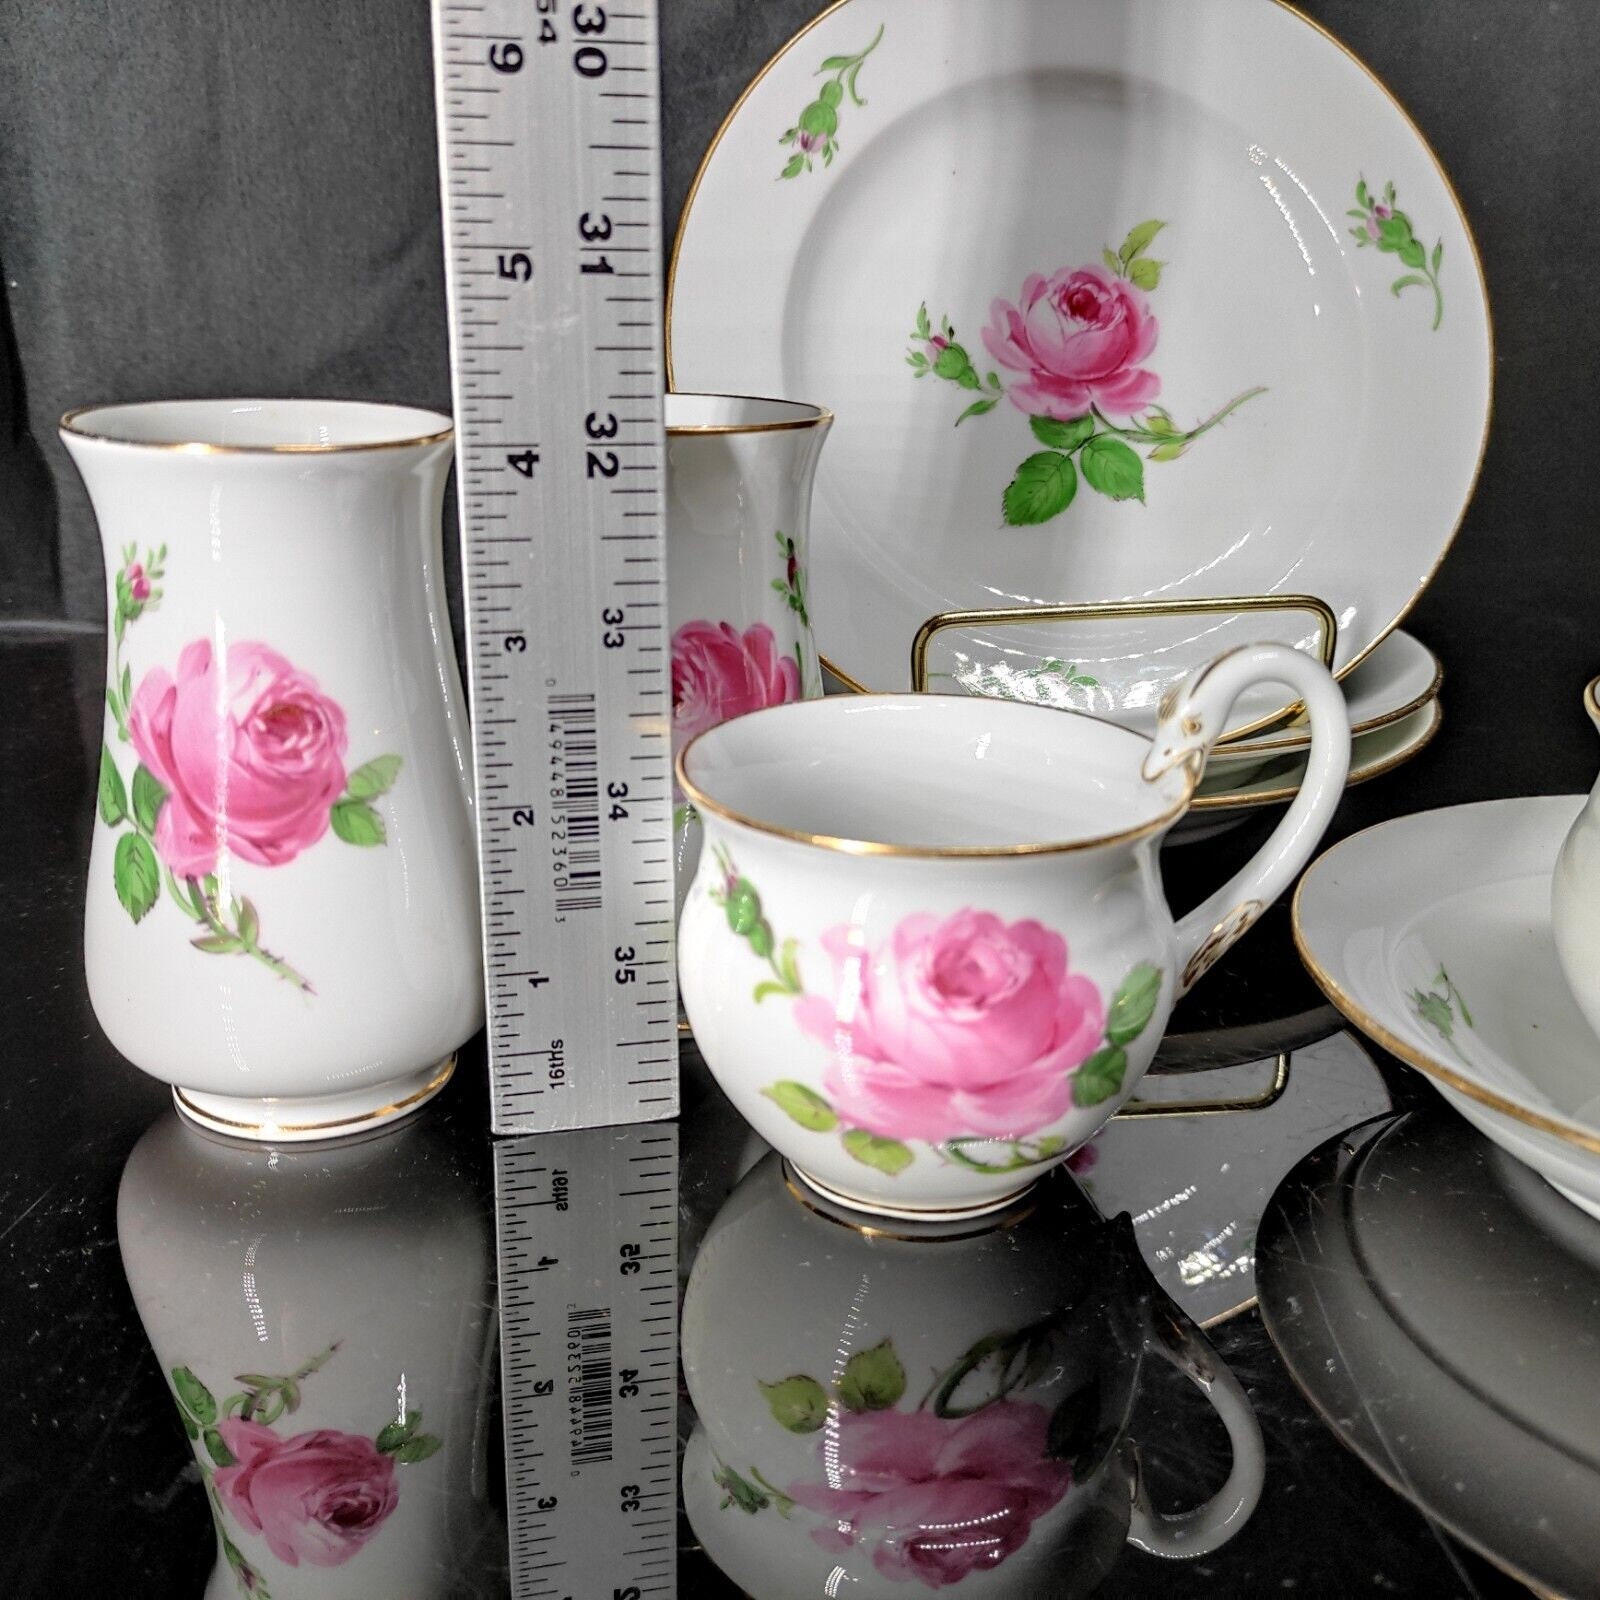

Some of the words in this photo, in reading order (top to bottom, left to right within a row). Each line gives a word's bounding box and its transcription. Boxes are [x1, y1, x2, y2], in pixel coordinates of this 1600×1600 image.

[489, 43, 523, 73] 6
[573, 4, 607, 78] 30
[579, 212, 615, 275] 31
[498, 253, 532, 283] 5
[507, 450, 539, 478] 4
[585, 412, 619, 479] 32
[505, 635, 526, 652] 3
[602, 608, 625, 649] 33
[549, 724, 564, 798] 49448
[513, 809, 534, 826] 2
[607, 782, 629, 821] 34
[551, 815, 568, 887] 52360
[528, 977, 549, 988] 1
[614, 946, 636, 985] 35
[548, 1039, 565, 1089] 16ths
